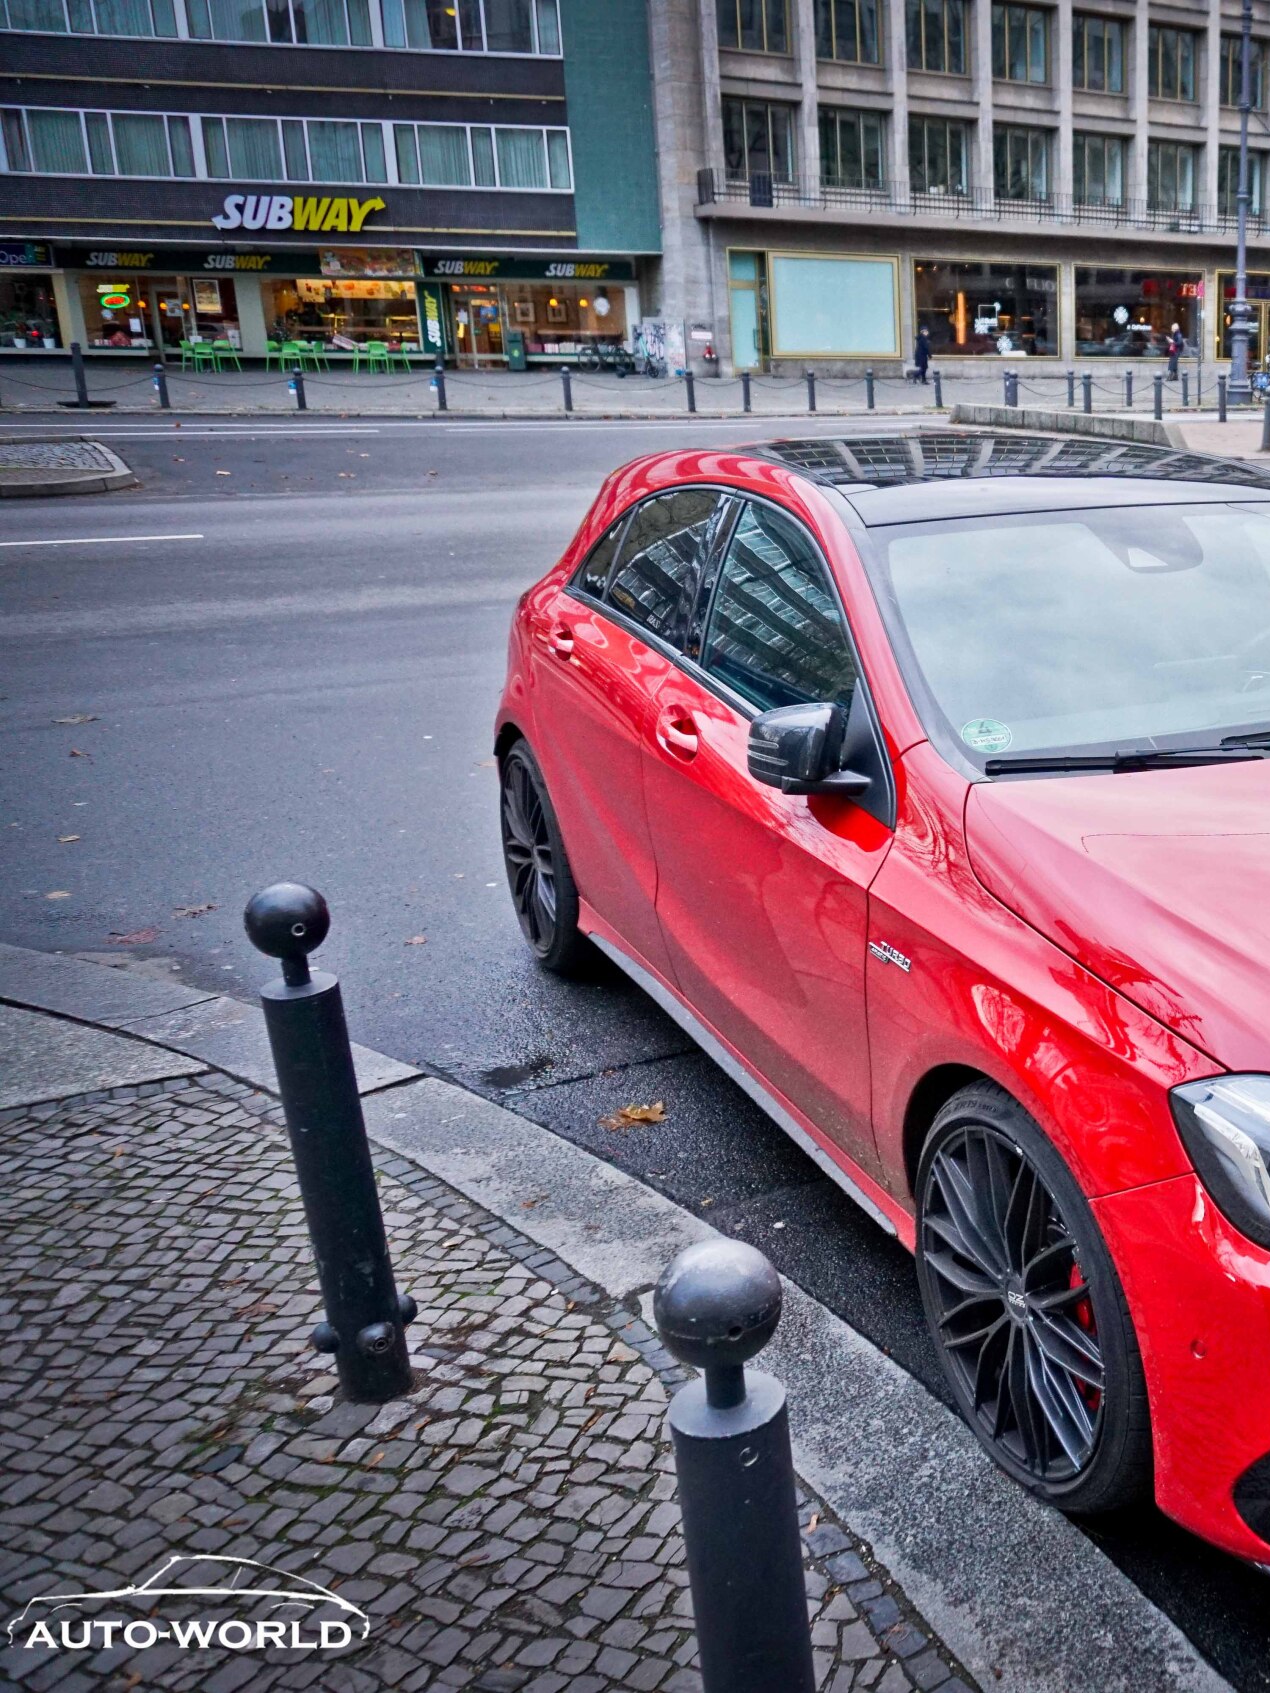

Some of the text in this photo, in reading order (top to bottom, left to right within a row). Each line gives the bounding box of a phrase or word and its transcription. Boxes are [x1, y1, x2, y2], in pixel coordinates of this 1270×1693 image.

[211, 195, 386, 231] SUBWAY
[86, 252, 155, 267] SUBWAY
[203, 254, 272, 270] SUBWAY
[433, 259, 500, 276] SUBWAY
[545, 263, 610, 278] SUBWAY
[423, 290, 442, 347] SUBWAY
[880, 940, 911, 970] TURBO
